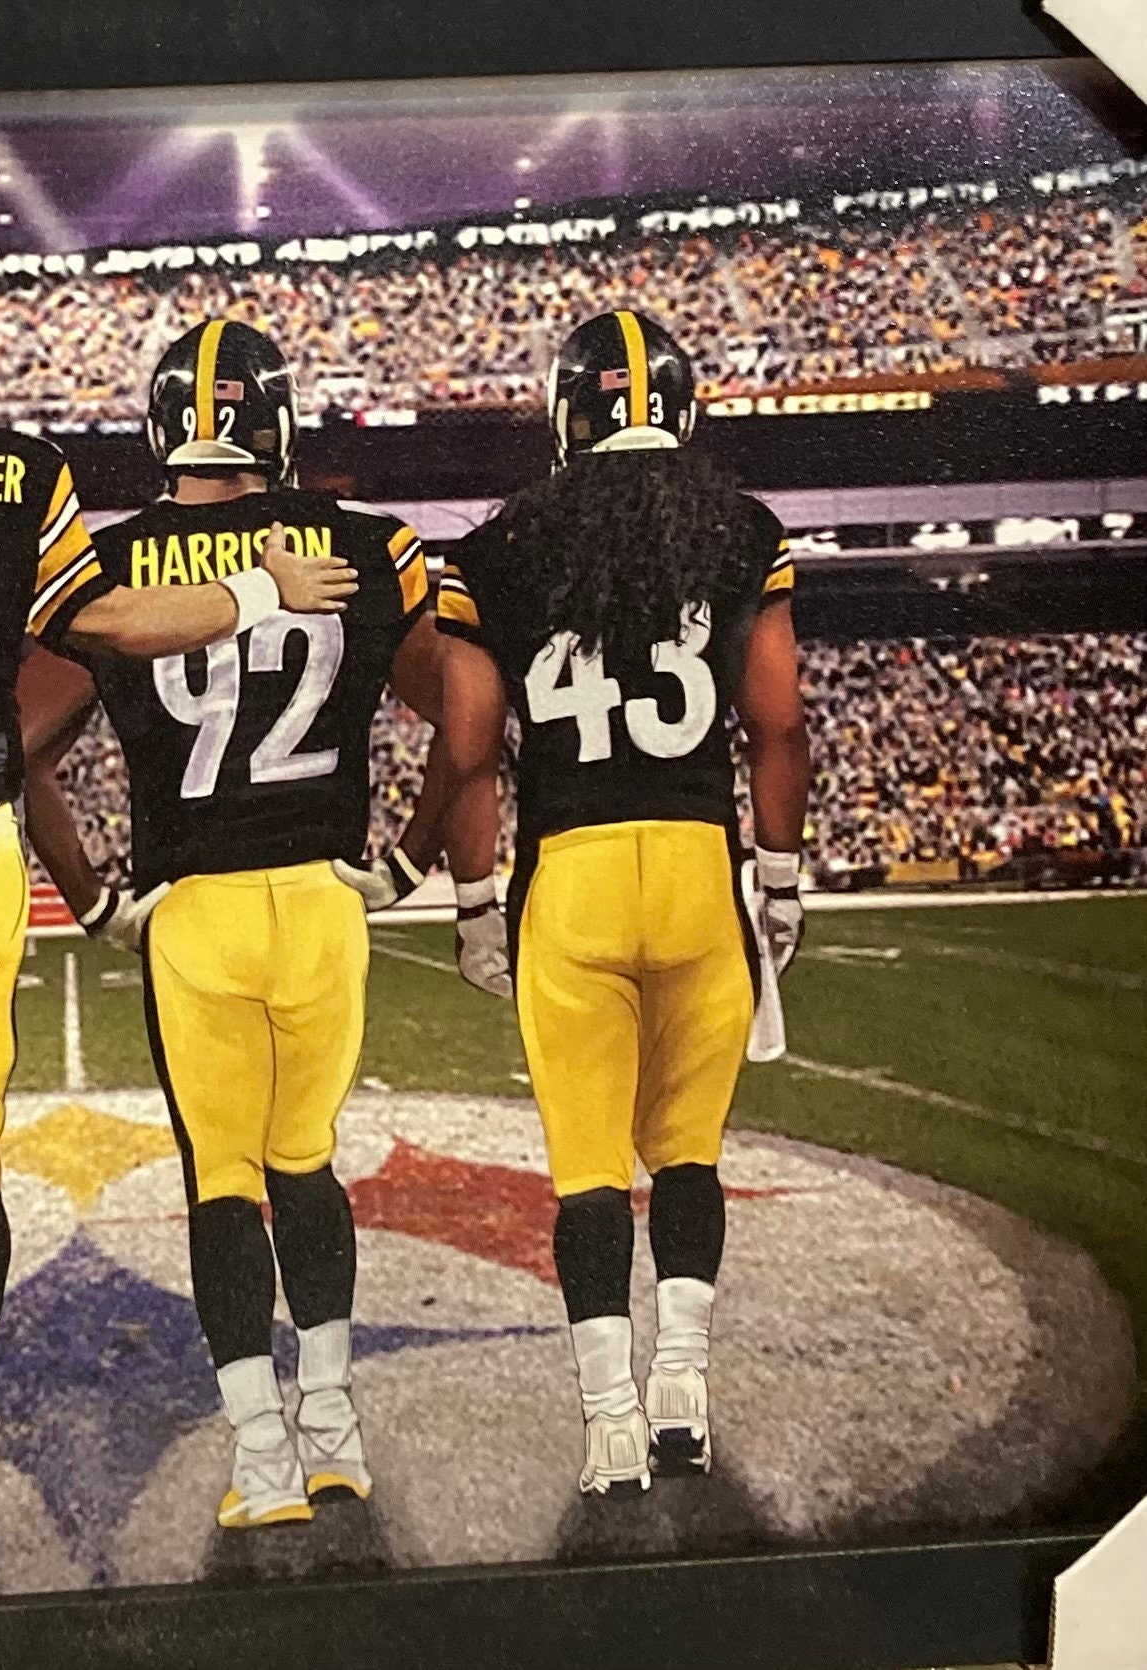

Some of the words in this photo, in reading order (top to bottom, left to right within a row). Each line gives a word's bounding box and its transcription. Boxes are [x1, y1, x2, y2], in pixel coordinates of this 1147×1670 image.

[182, 406, 236, 443] 92
[611, 392, 664, 428] 43
[153, 609, 344, 799] 92
[524, 600, 717, 762] 43
